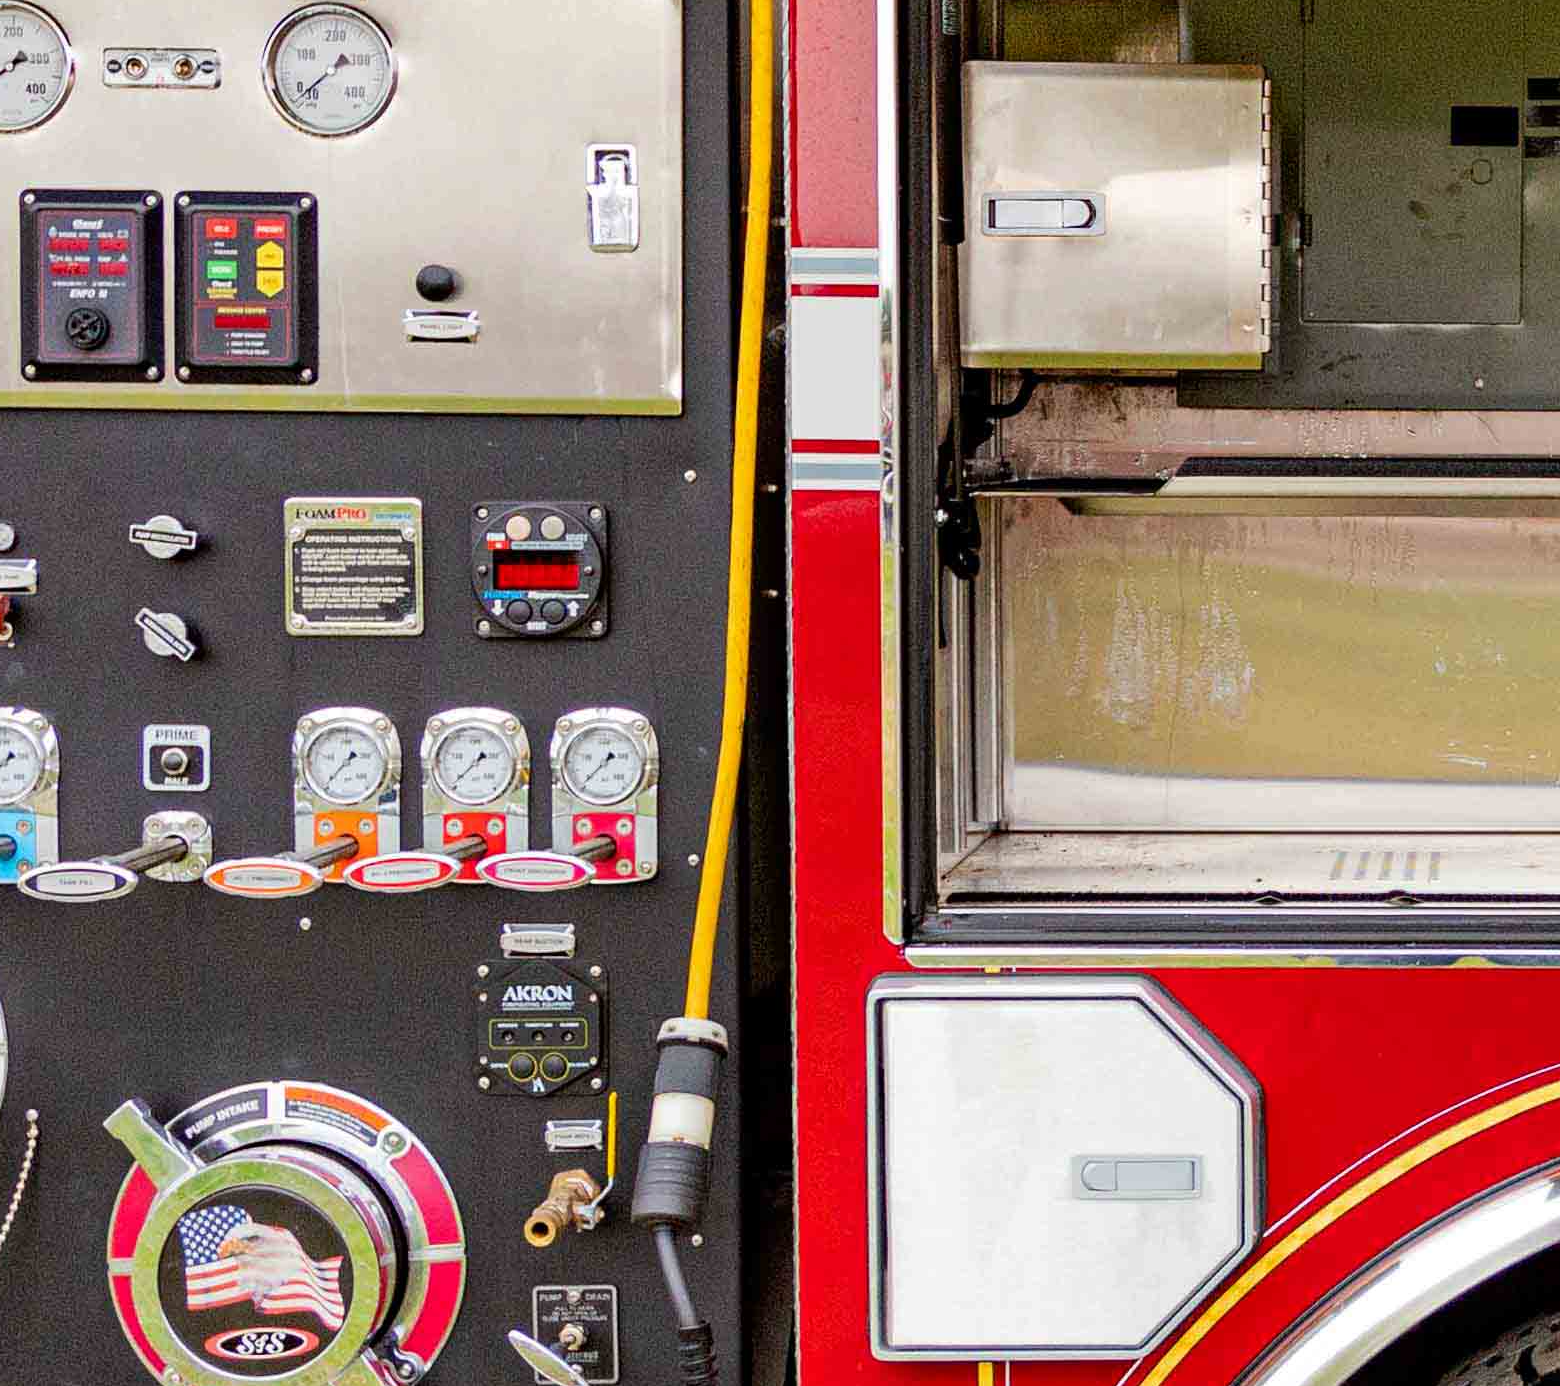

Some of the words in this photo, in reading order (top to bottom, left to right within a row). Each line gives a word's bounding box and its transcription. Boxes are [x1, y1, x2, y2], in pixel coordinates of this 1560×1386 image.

[3, 25, 24, 38] 200
[324, 29, 346, 43] 200
[29, 54, 49, 66] 300
[297, 49, 316, 62] 100
[350, 54, 371, 66] 300
[25, 82, 47, 95] 400
[343, 86, 365, 100] 400
[154, 729, 197, 740] PRIME
[503, 985, 574, 1002] AKRON
[185, 1114, 216, 1140] PUMP
[215, 1098, 260, 1124] INTAKE
